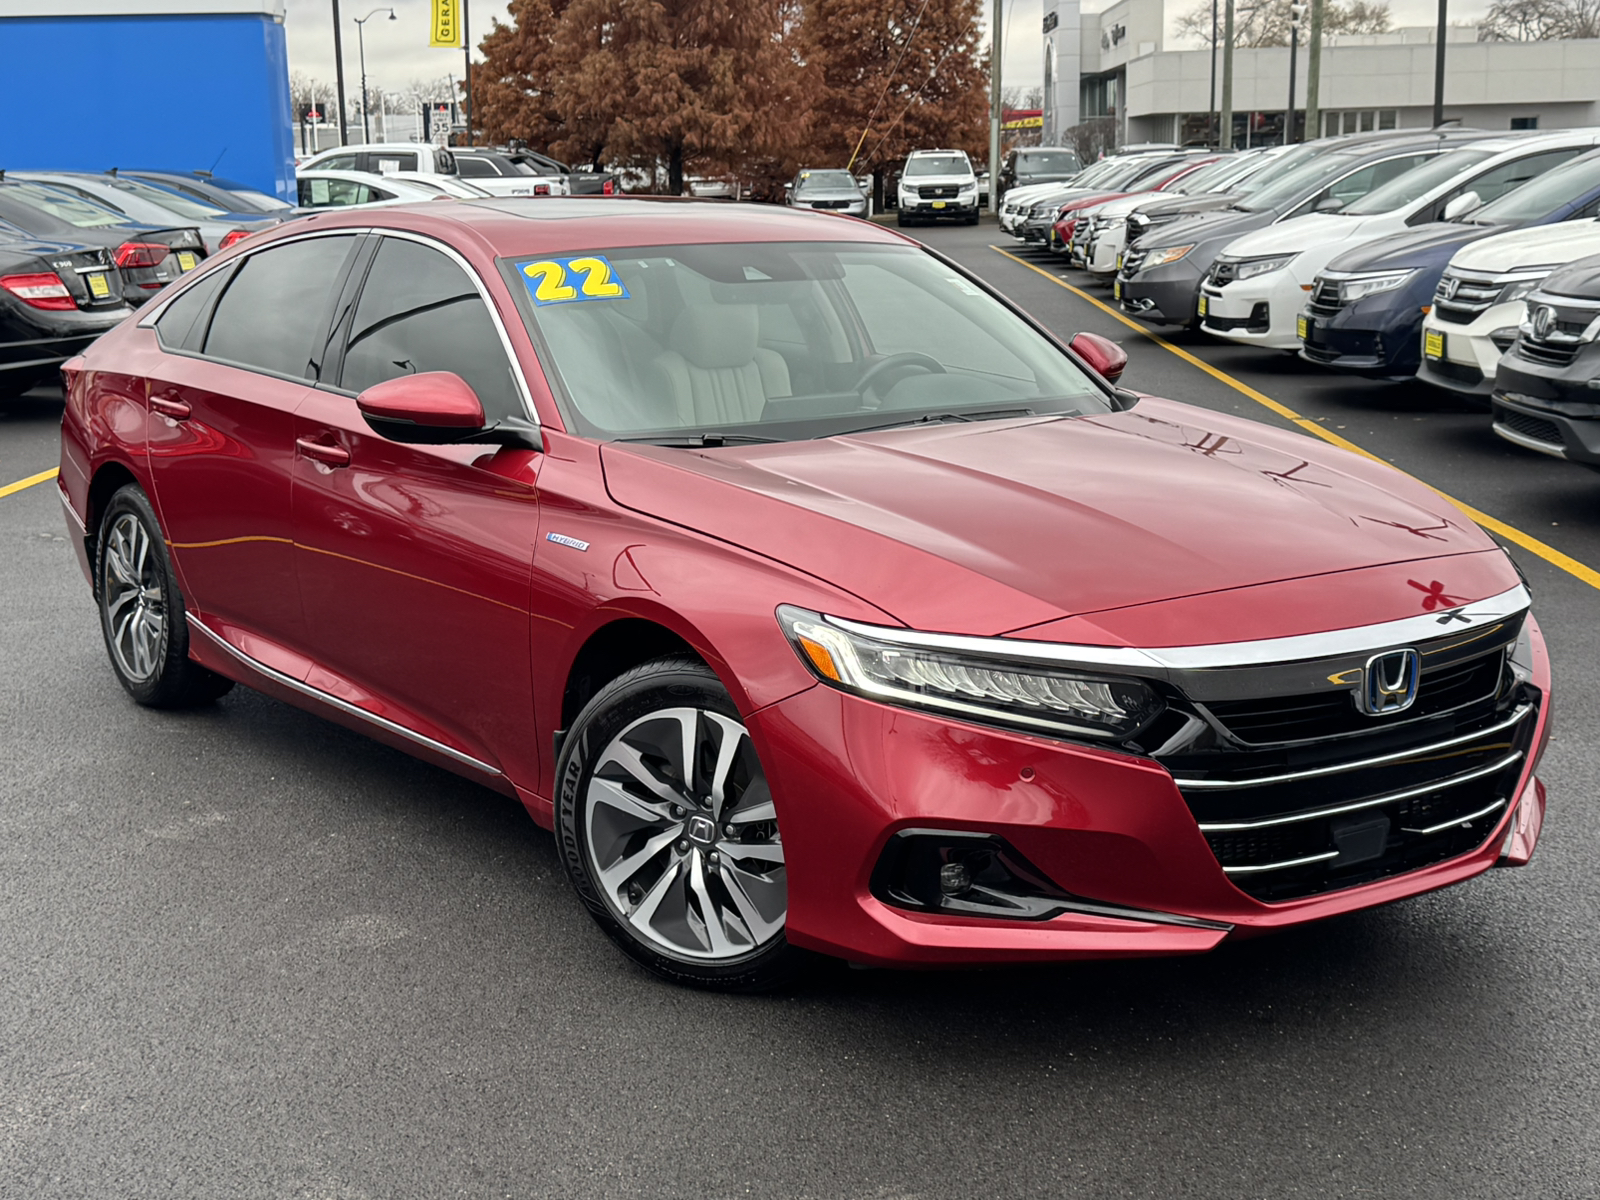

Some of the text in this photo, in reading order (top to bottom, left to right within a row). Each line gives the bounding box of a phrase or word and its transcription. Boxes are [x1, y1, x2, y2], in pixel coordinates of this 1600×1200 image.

[433, 123, 449, 133] 35
[523, 257, 622, 302] 22
[551, 534, 586, 549] HYBRID
